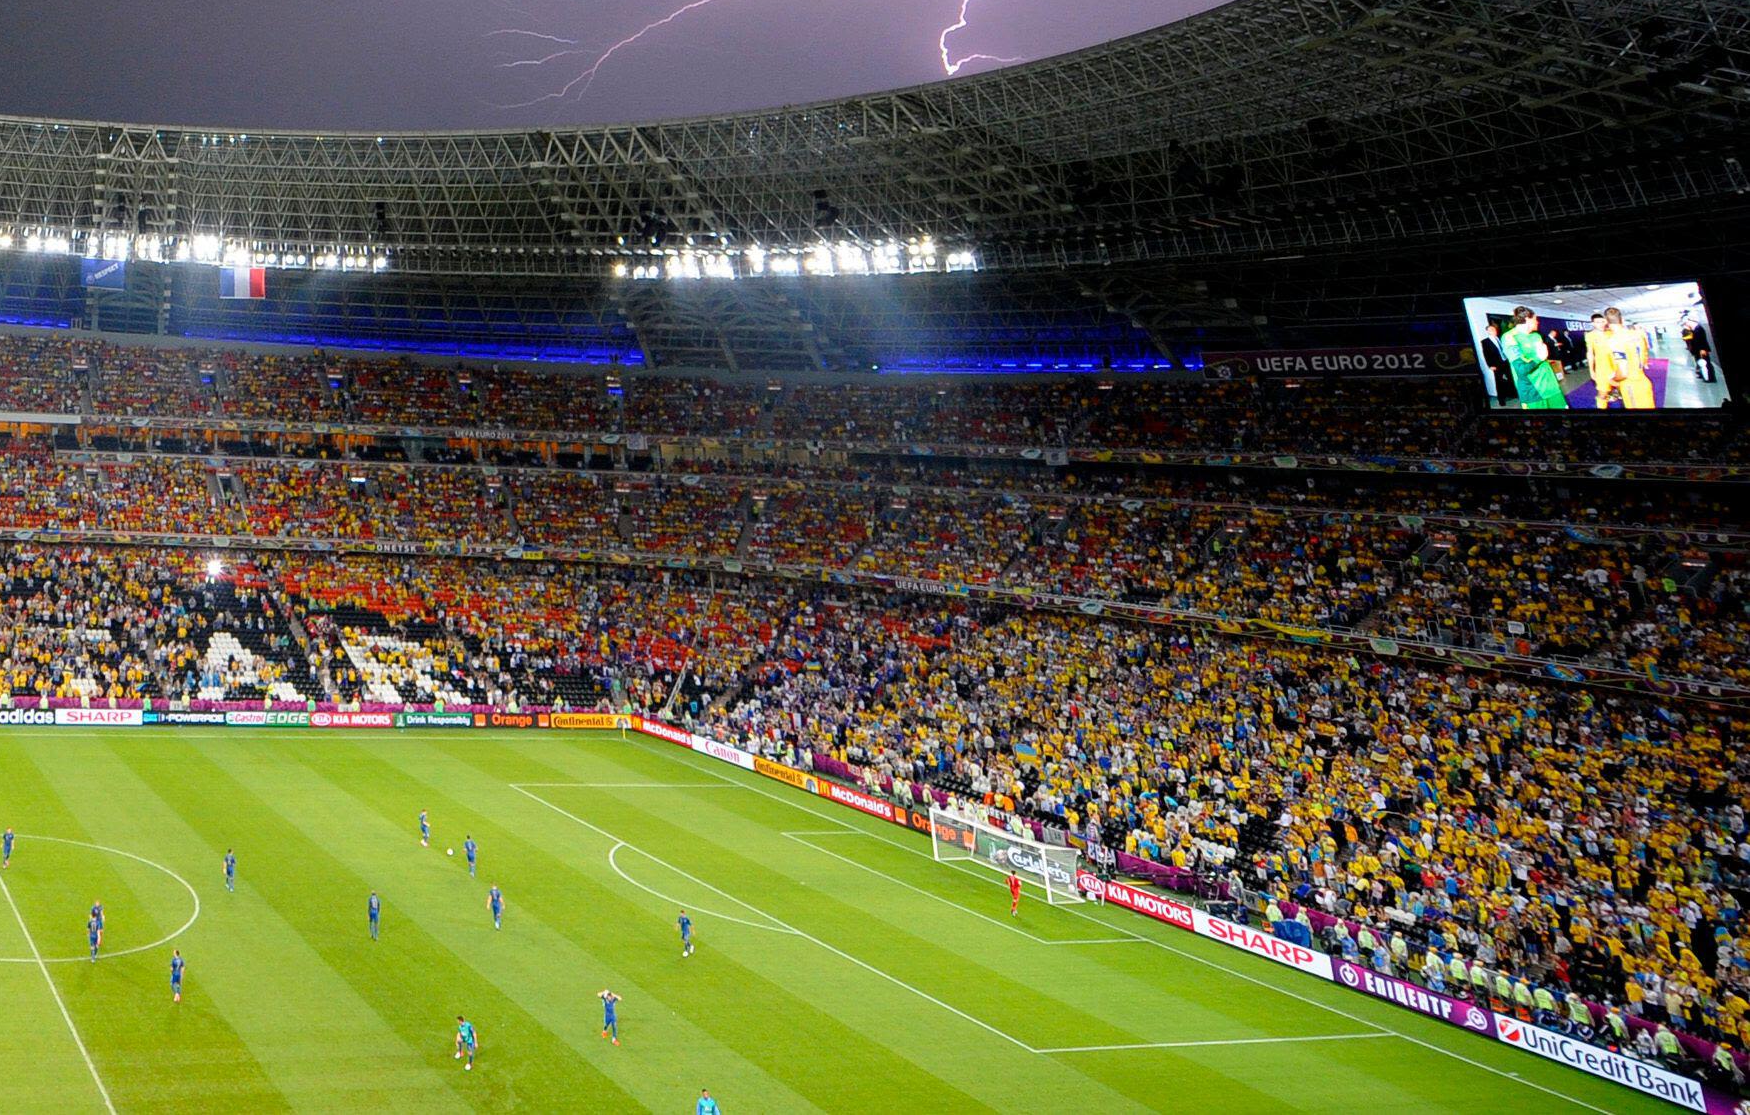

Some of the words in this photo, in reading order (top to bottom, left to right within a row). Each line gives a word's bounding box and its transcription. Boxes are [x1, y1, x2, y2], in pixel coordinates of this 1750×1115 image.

[94, 263, 119, 280] RESPECT
[1256, 357, 1309, 372] UEFA
[1311, 355, 1368, 371] EURO
[1371, 353, 1426, 369] 2012
[376, 544, 416, 553] ONETSK
[66, 711, 132, 723] SHARP
[235, 713, 265, 723] Castrol
[266, 713, 308, 724] EDGE
[333, 714, 350, 724] KIA
[351, 714, 391, 725] MOTORS
[406, 715, 427, 724] Drink
[428, 715, 471, 726] Responsibly
[491, 713, 533, 727] Orange
[553, 716, 605, 727] Continental
[704, 740, 740, 765] Canon
[754, 758, 796, 785] Continental
[831, 785, 892, 817] McDonald's
[912, 812, 957, 840] Orange
[1083, 878, 1103, 895] KIA
[1107, 885, 1131, 904] KIA
[1133, 893, 1192, 925] MOTORS
[1208, 918, 1314, 965] SHARP
[1522, 1026, 1632, 1083] UniCredit
[1637, 1064, 1702, 1109] Bank
